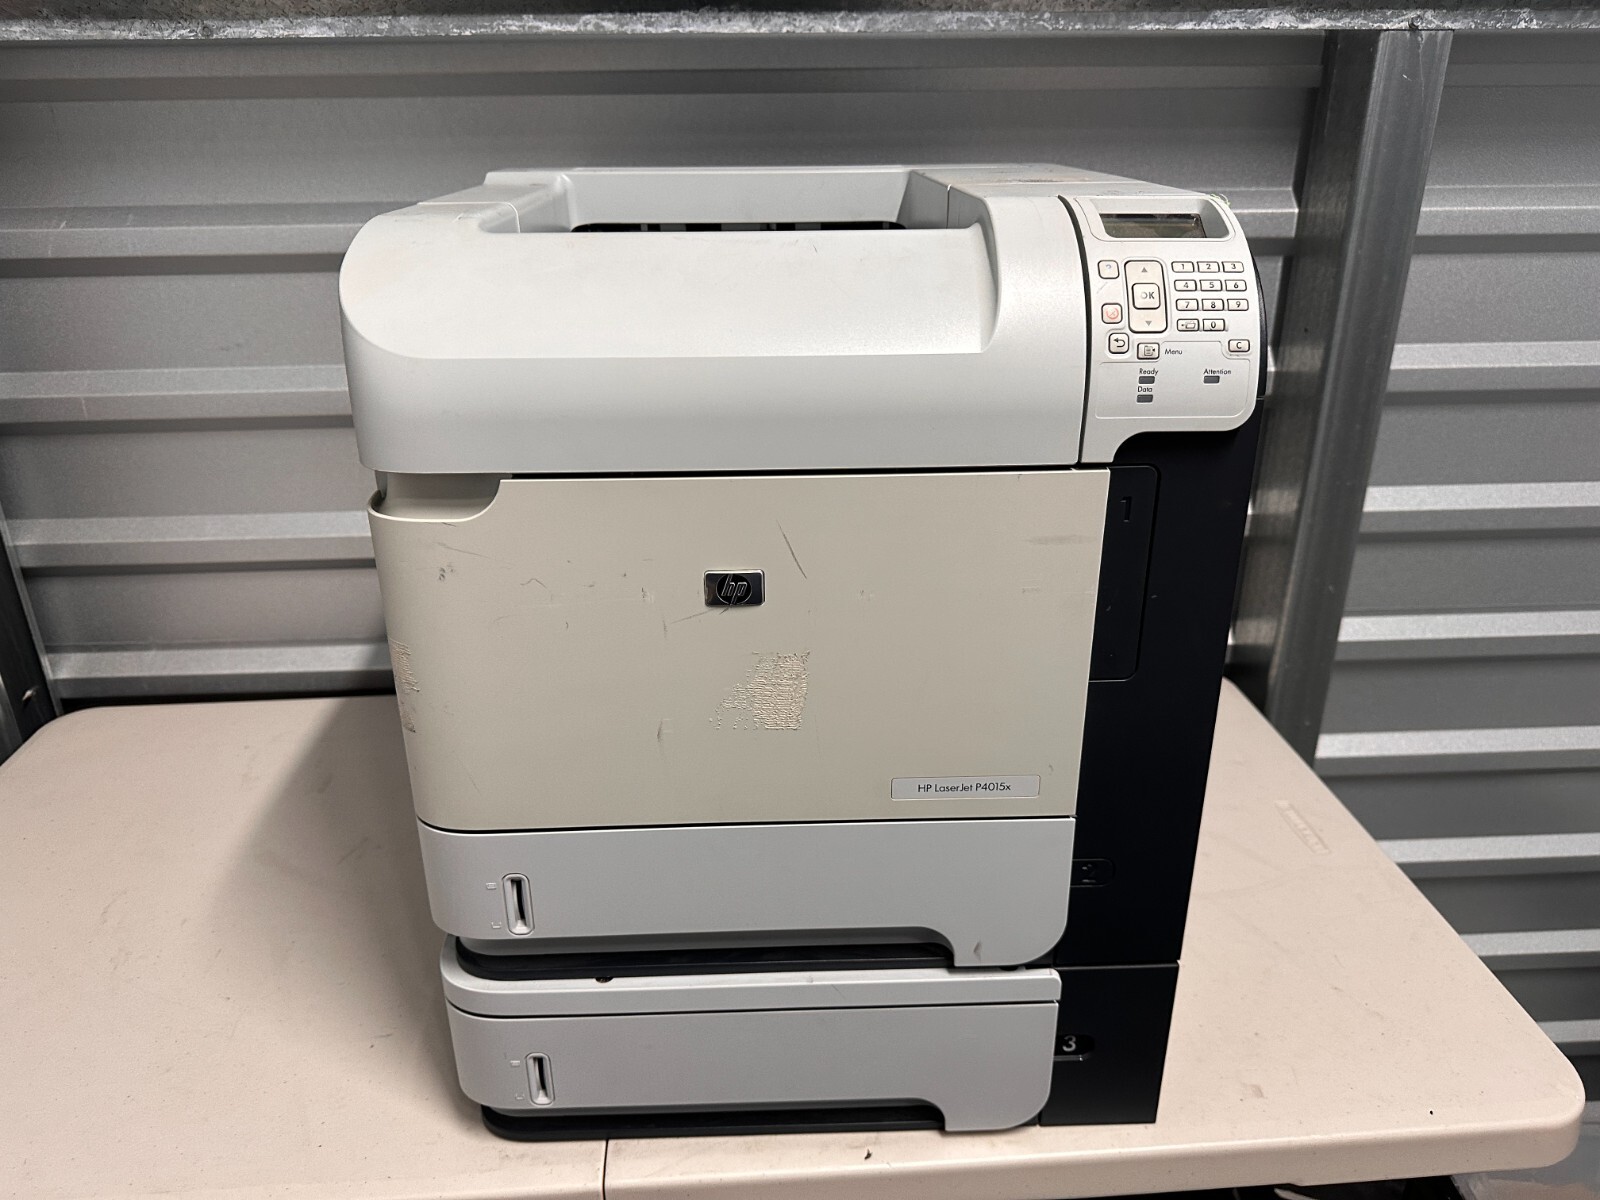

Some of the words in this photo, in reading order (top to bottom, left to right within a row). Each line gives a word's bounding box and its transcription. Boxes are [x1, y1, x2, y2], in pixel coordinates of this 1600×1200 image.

[1140, 291, 1155, 300] OK
[1185, 301, 1190, 309] 7
[1210, 301, 1216, 309] 8
[1210, 321, 1216, 329] 0
[1139, 368, 1158, 376] Ready
[1120, 496, 1132, 522] 1
[720, 574, 748, 605] hp
[917, 784, 933, 793] HP
[934, 783, 973, 793] LaserJet
[975, 782, 1011, 792] P4015x
[1062, 1035, 1077, 1052] 3
